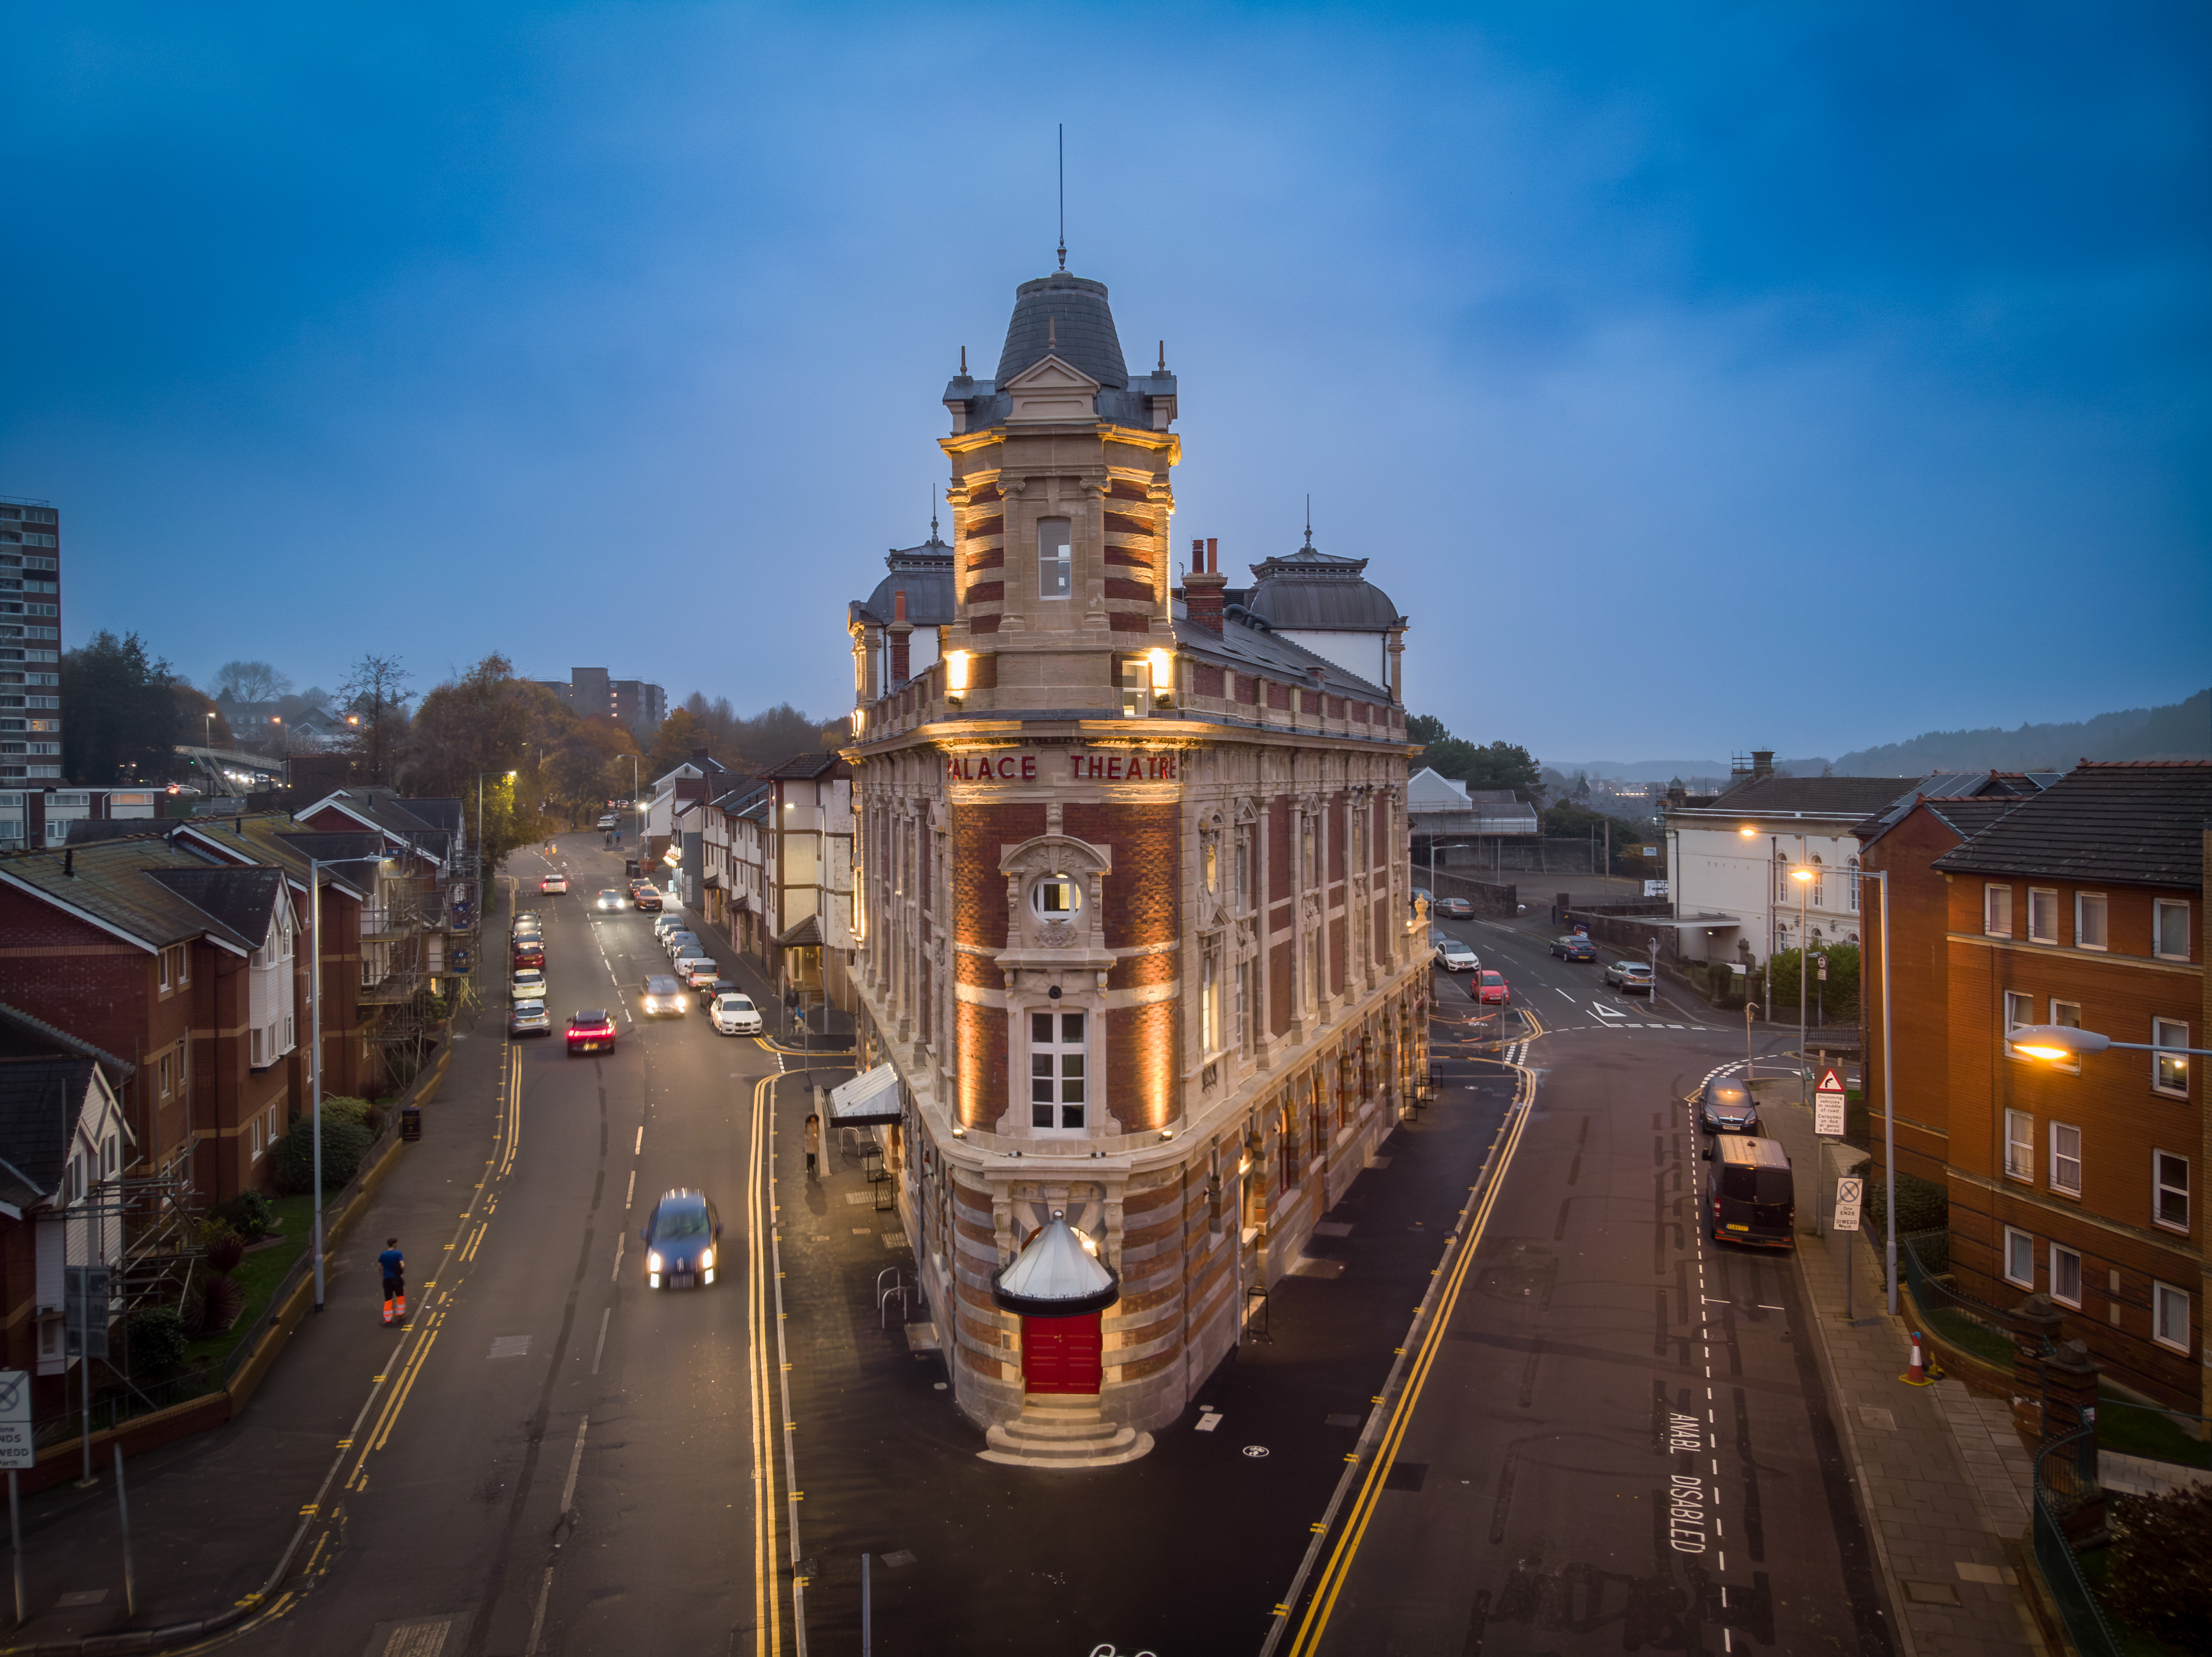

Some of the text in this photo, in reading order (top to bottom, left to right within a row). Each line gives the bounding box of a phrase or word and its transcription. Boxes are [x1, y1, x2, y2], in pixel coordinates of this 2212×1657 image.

[1070, 755, 1176, 780] THEATRE
[1669, 1412, 1706, 1553] ANABL DISABLED
